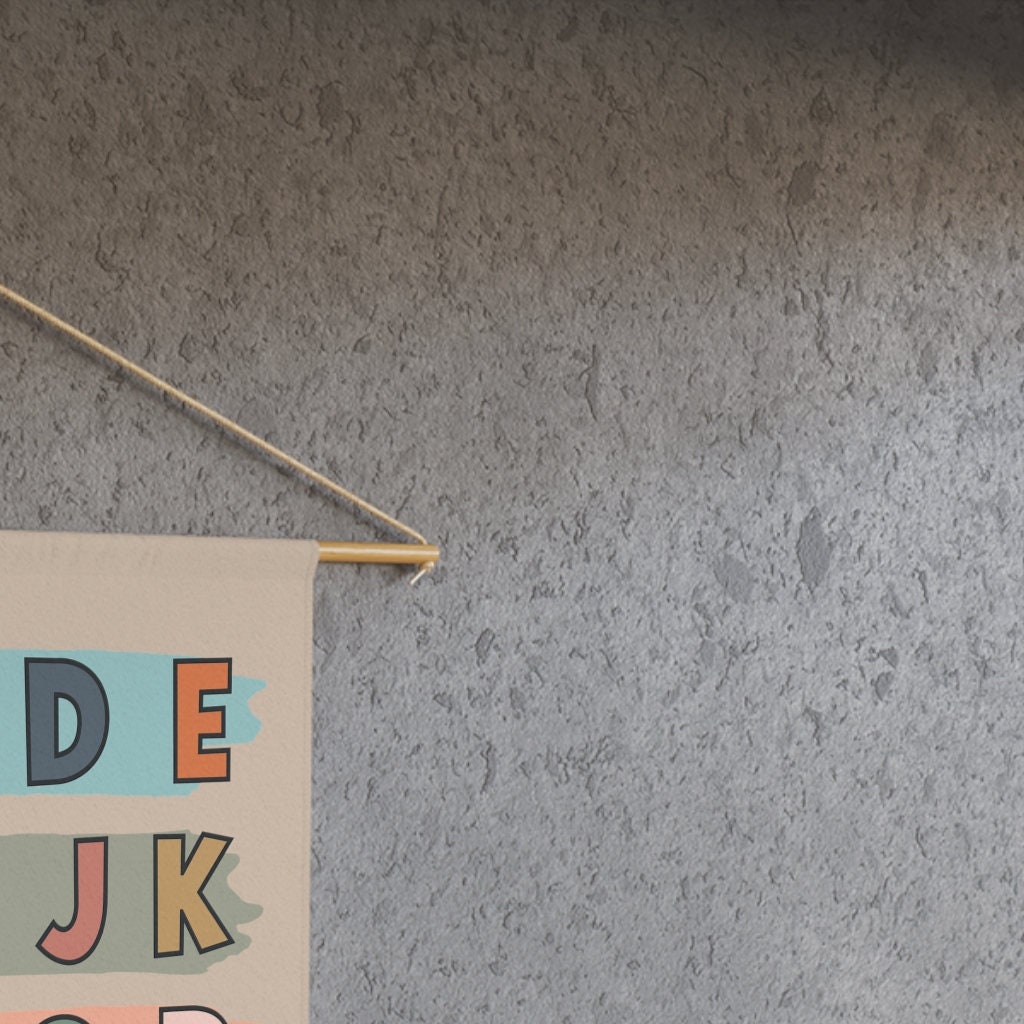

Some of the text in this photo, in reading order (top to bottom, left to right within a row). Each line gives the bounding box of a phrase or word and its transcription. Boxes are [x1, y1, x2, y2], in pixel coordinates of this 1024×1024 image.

[24, 657, 110, 787] D
[172, 657, 233, 784] E
[35, 836, 109, 966] J
[152, 831, 236, 959] K
